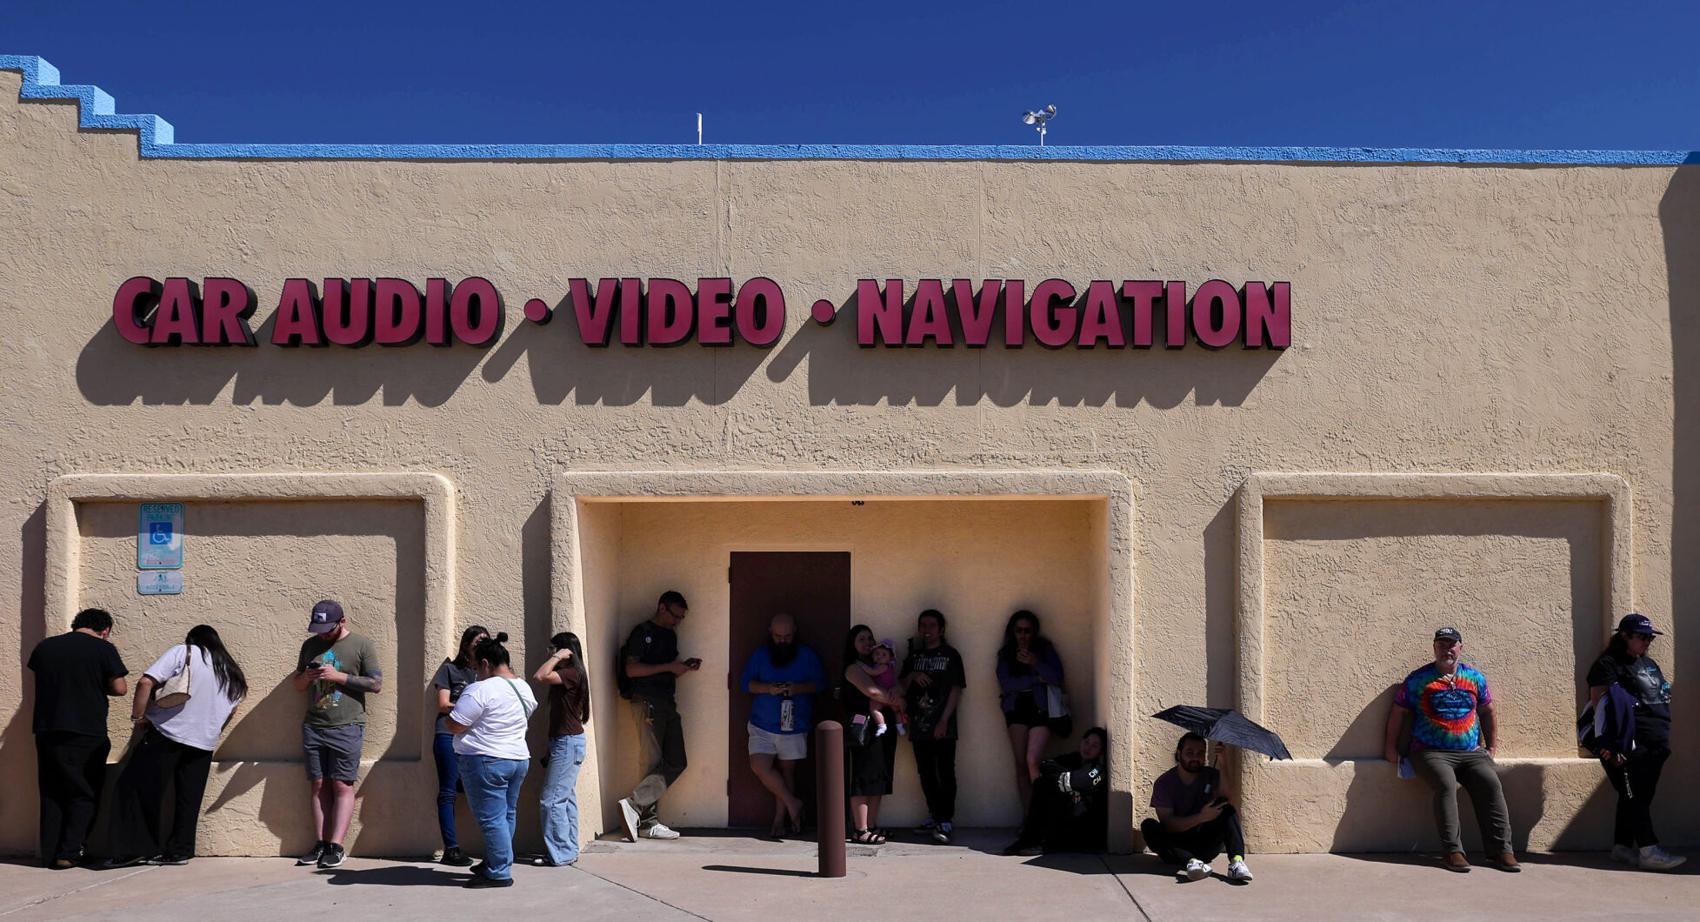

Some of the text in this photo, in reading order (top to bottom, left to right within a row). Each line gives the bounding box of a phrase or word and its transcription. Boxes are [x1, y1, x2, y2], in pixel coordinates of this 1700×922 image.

[113, 277, 1291, 348] CAR AUDIO VIDEO NAVIGATION
